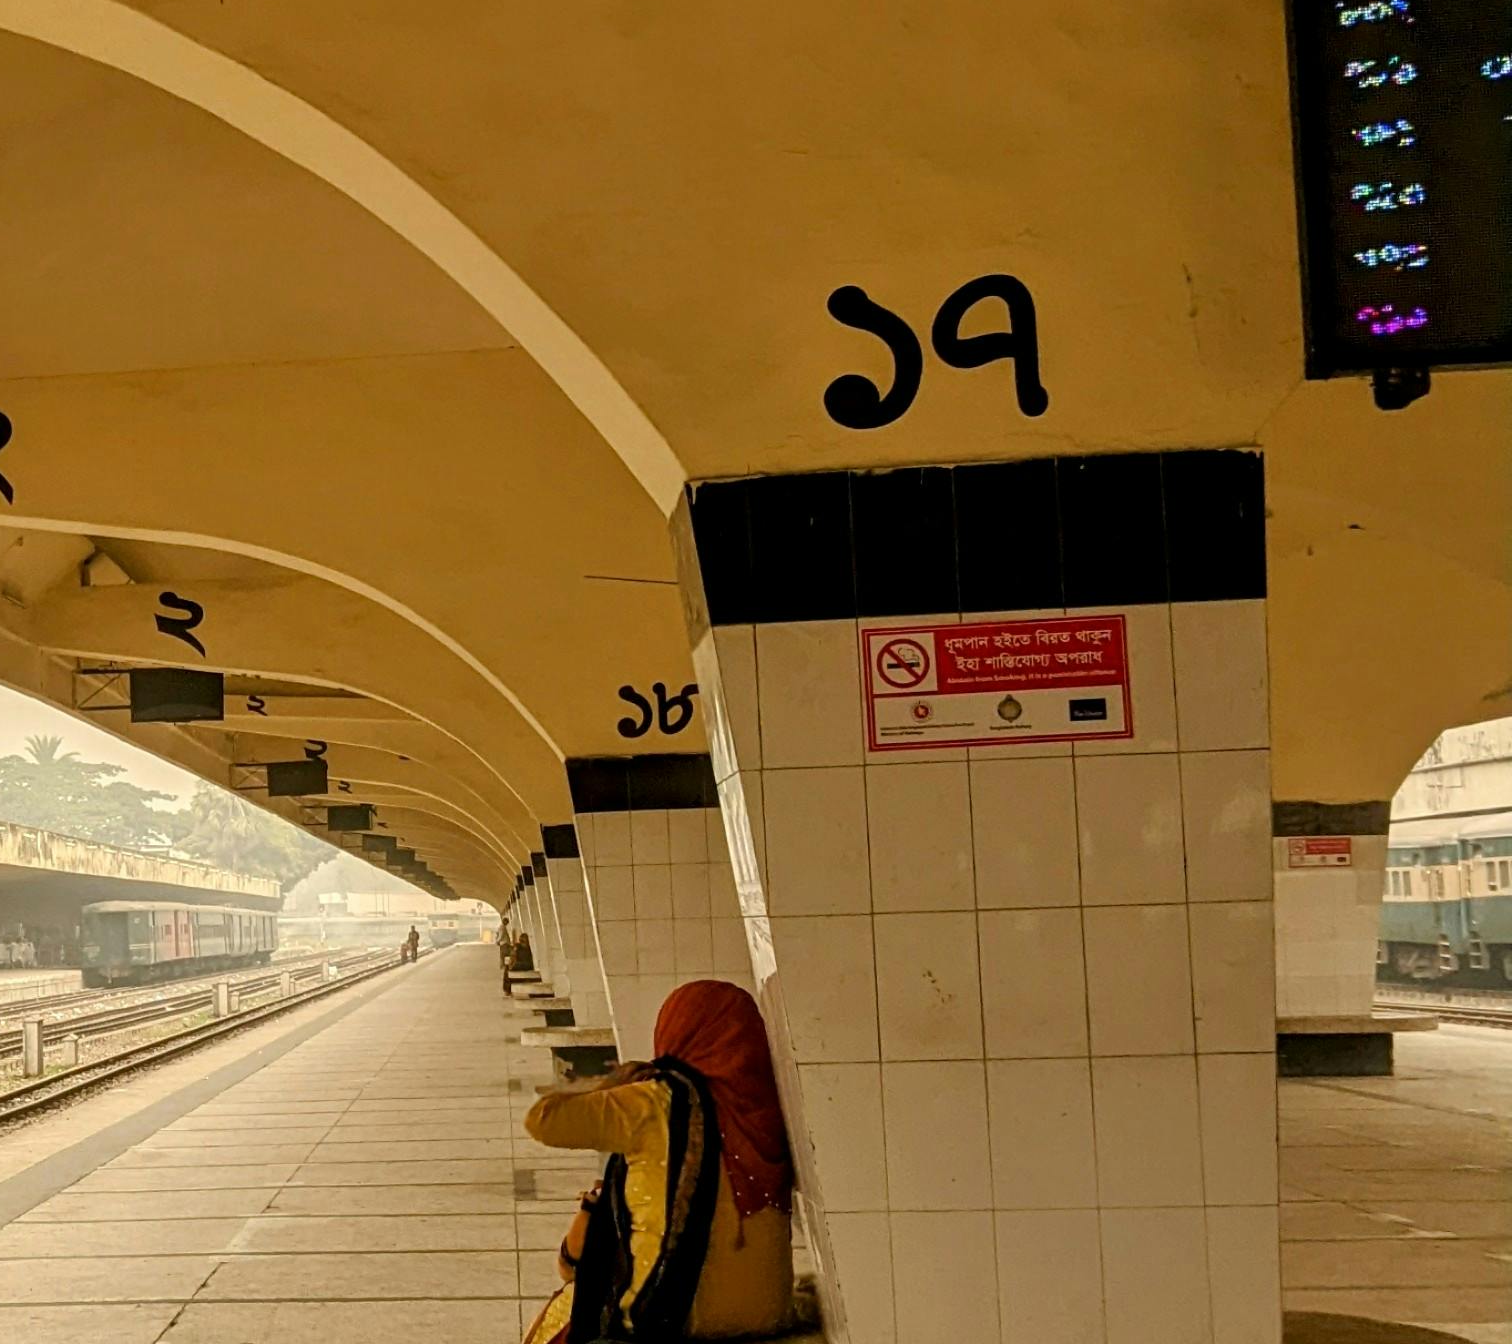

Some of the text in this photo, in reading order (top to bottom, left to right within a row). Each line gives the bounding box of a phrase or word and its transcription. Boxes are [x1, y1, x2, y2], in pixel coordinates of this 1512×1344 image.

[823, 274, 1049, 430] ১৭
[154, 591, 206, 658] ২
[944, 628, 1112, 654] ধূমপান হইতে বিরত থাকুন
[955, 650, 1103, 672] ইহা শাস্তিযোগ্য অপরাধ
[246, 695, 268, 716] ২
